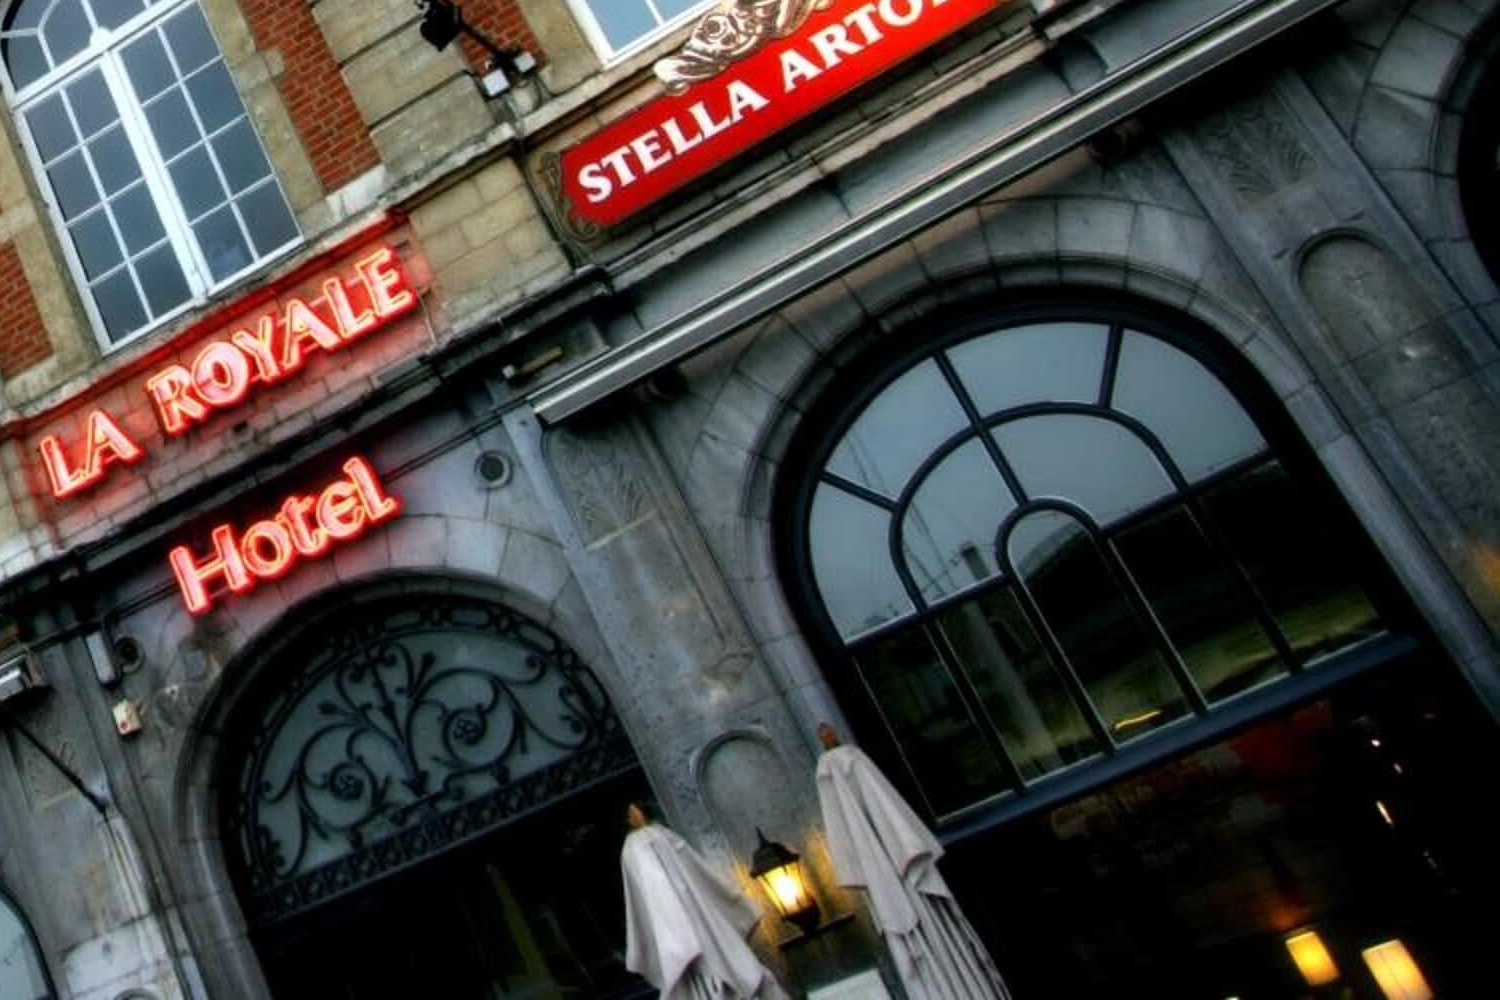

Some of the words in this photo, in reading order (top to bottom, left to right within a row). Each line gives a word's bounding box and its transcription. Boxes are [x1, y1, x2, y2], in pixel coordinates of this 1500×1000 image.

[576, 79, 770, 203] STELLA
[38, 409, 142, 497] LA
[147, 247, 417, 435] ROYALE
[169, 455, 399, 614] Hotel
